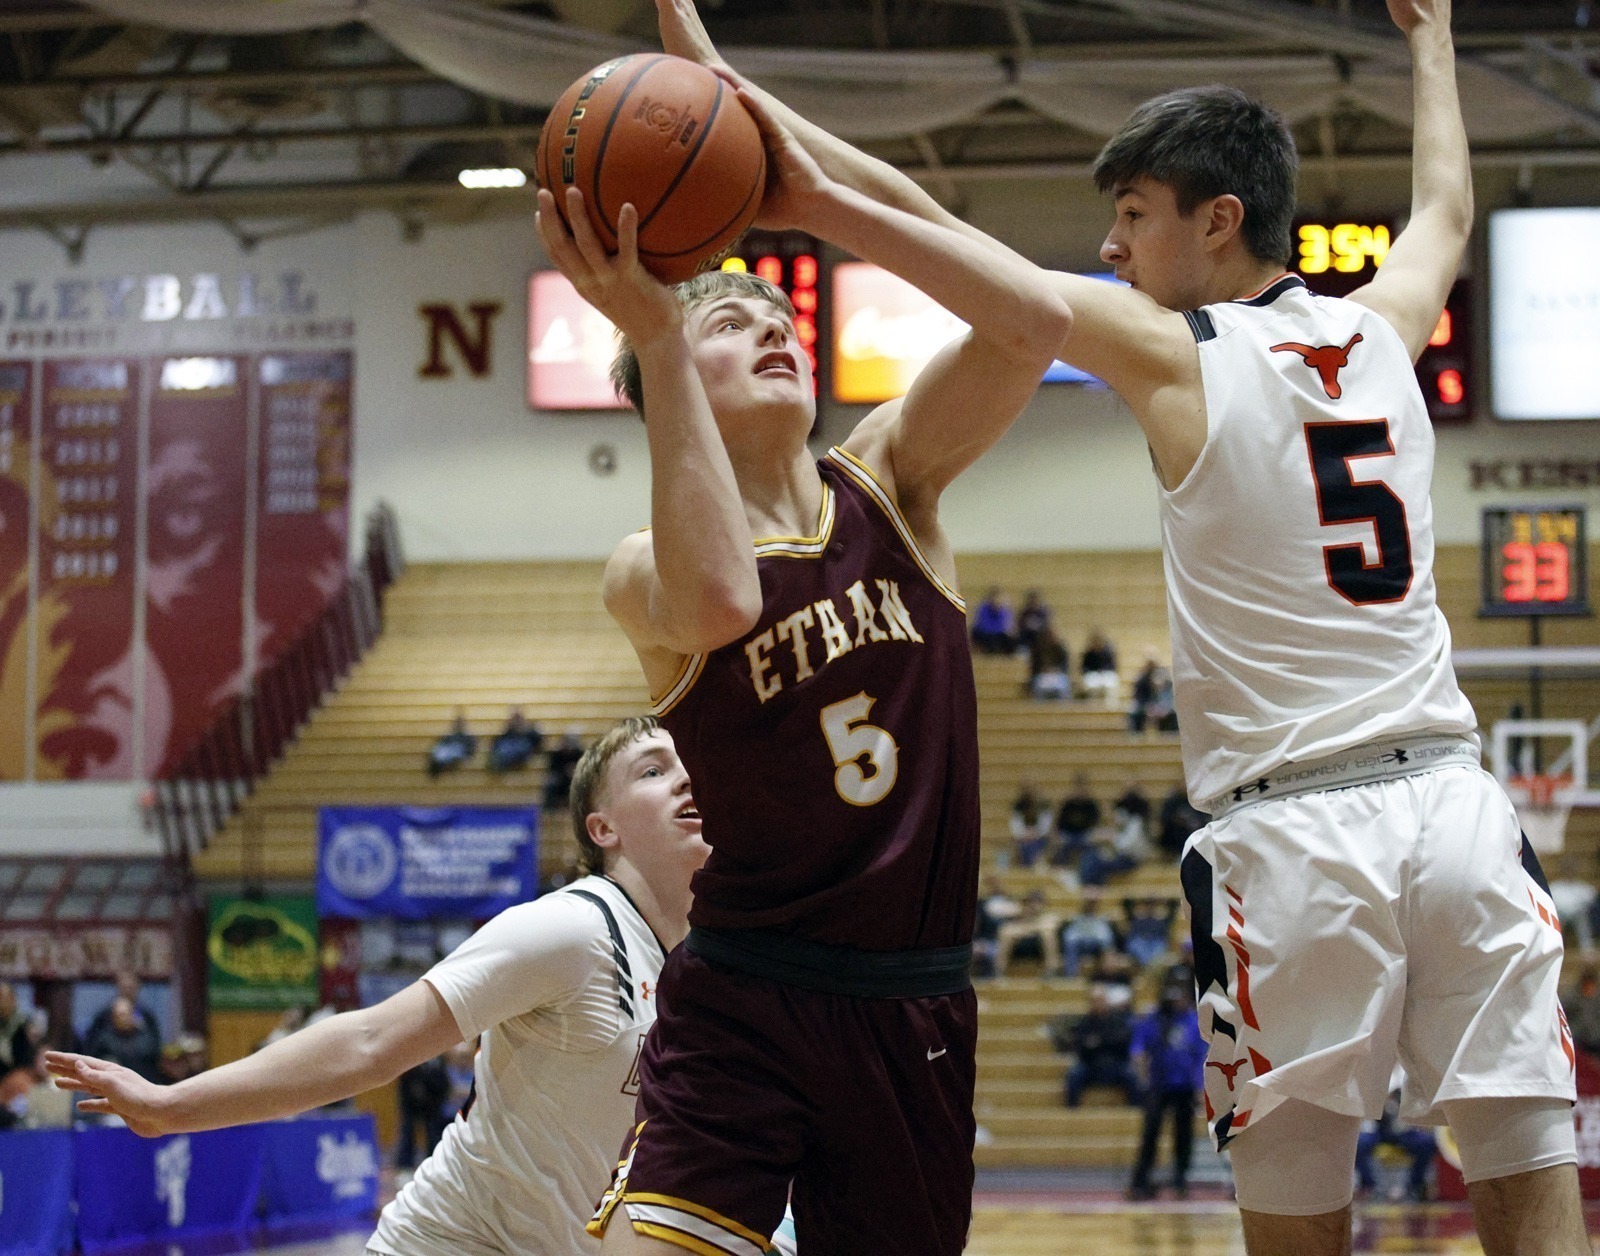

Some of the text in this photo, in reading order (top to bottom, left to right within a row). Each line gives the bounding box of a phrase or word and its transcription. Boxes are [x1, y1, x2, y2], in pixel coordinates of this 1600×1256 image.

[0, 271, 317, 321] LEYBALL
[417, 303, 504, 377] N
[1304, 417, 1414, 607] 5
[1502, 541, 1569, 602] 33
[744, 578, 925, 704] ETHAN
[820, 690, 900, 807] 5
[1276, 761, 1348, 784] ARMOUR
